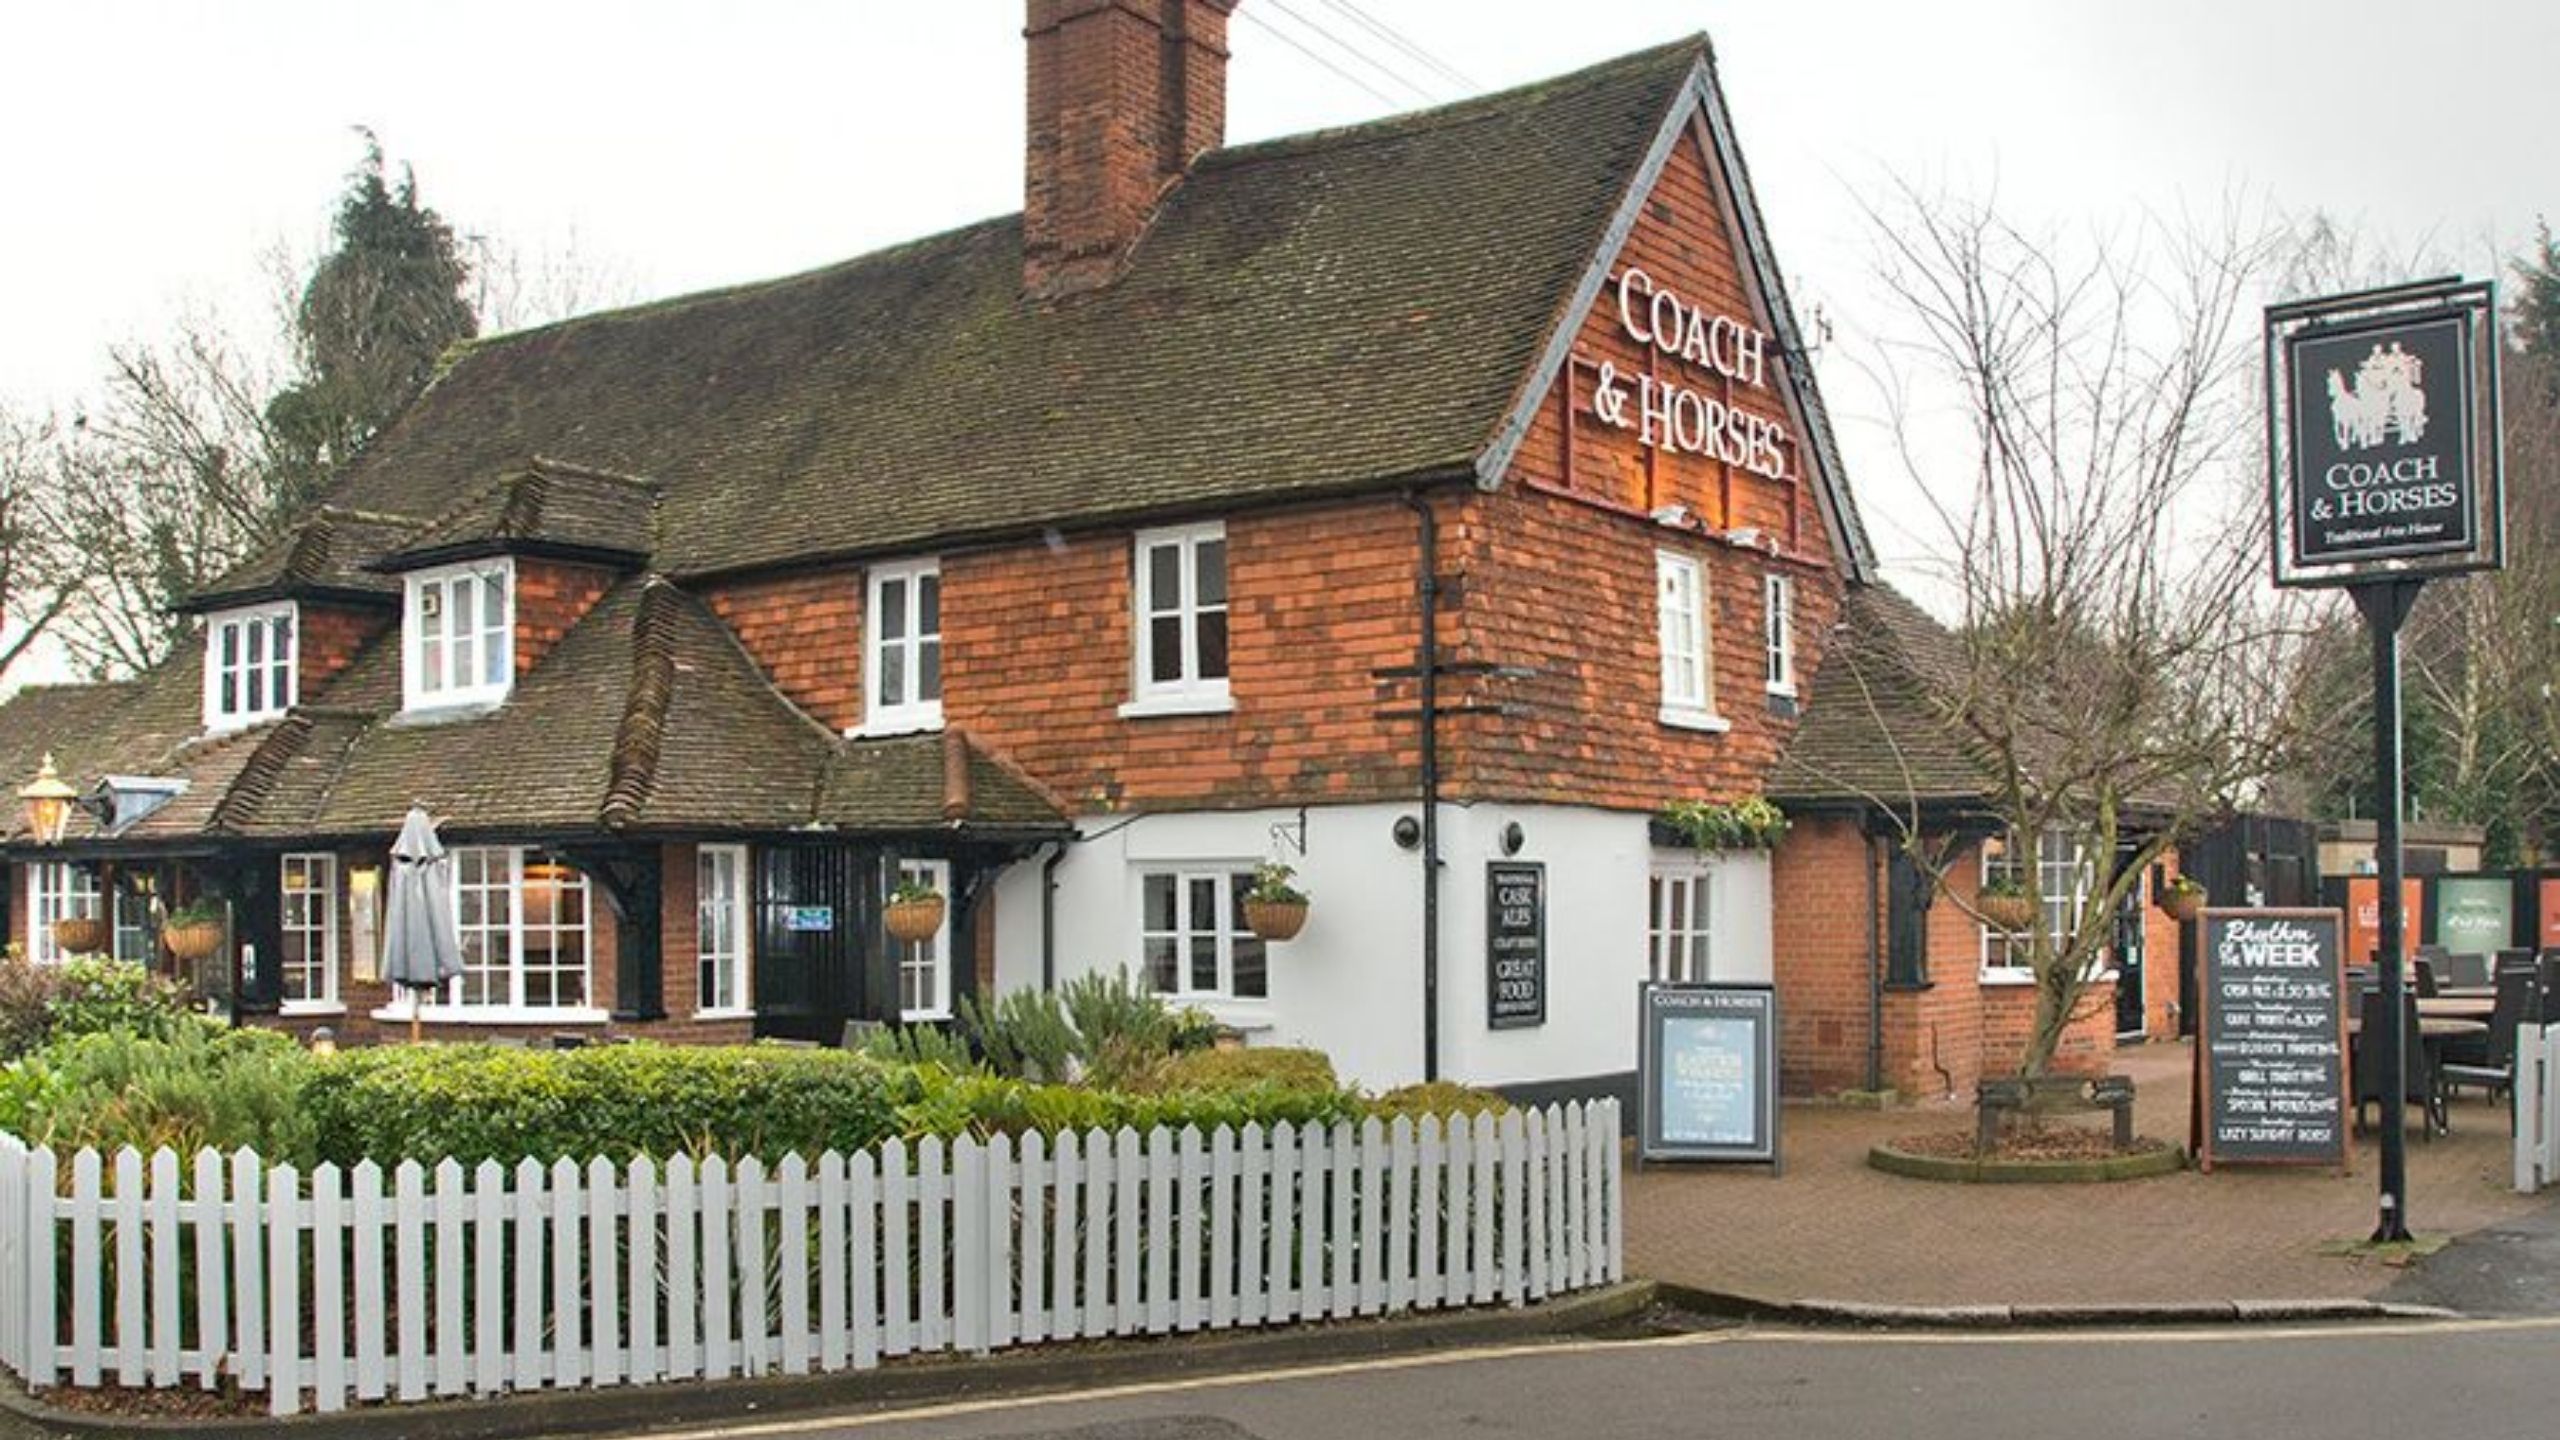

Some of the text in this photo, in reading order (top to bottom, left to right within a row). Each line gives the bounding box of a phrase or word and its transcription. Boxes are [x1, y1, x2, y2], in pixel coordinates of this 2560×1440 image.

[1619, 267, 1765, 387] COACH
[1594, 361, 1786, 481] & HORSES
[2326, 456, 2438, 490] COACH
[2311, 483, 2457, 521] & HORSES
[2241, 943, 2322, 969] WEEK
